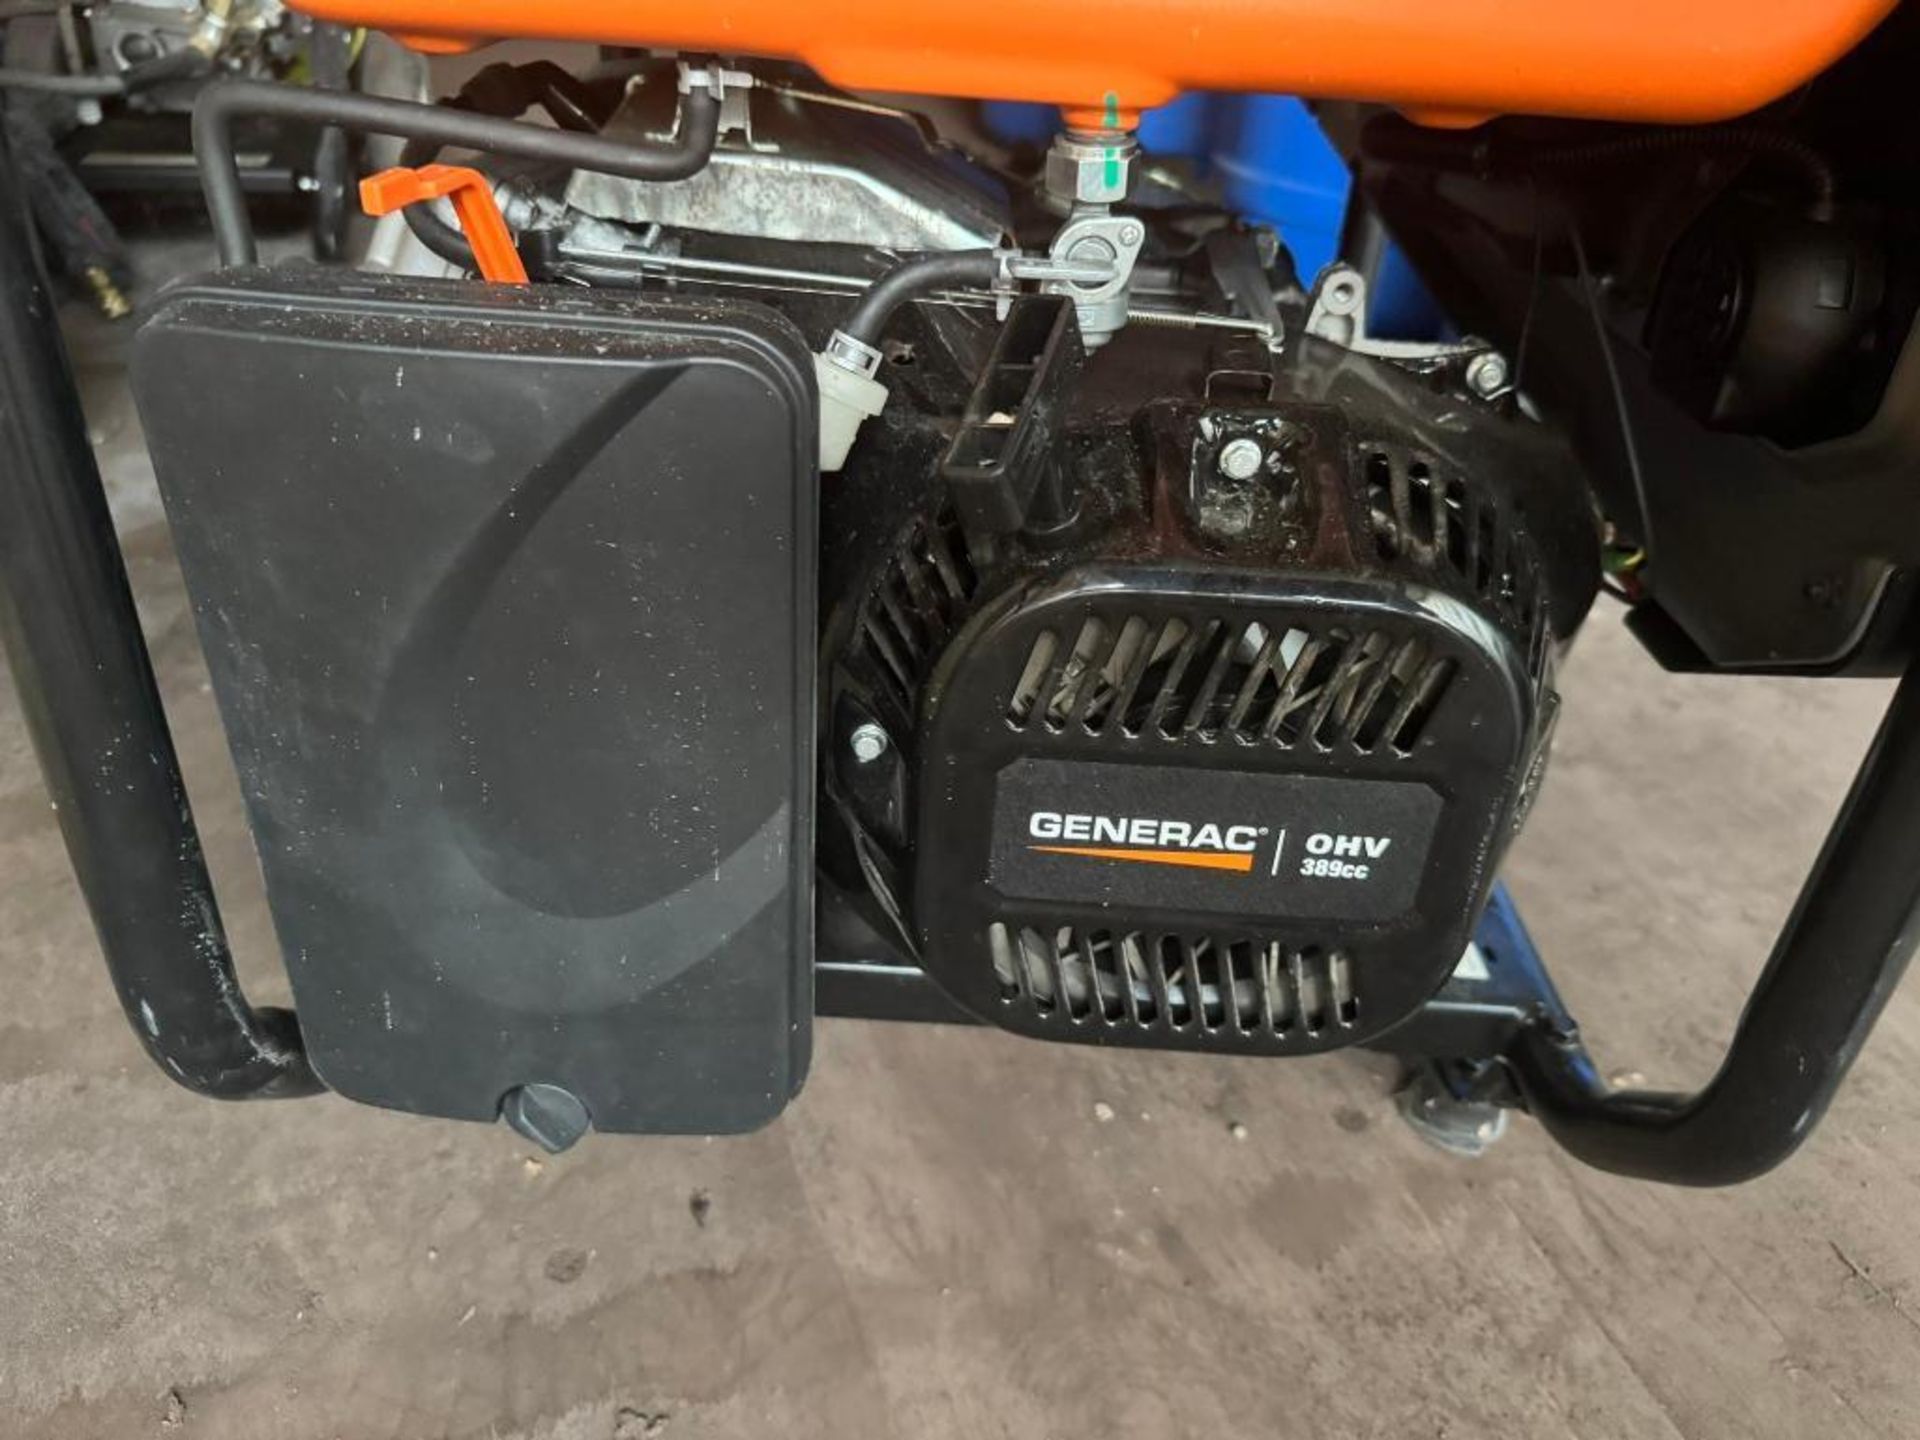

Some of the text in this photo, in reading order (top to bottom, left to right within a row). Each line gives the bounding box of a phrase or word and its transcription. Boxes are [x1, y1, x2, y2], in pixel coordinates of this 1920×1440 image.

[1029, 811, 1258, 851] GENERAC
[1305, 833, 1391, 858] OHV
[1300, 857, 1369, 880] 389cc
